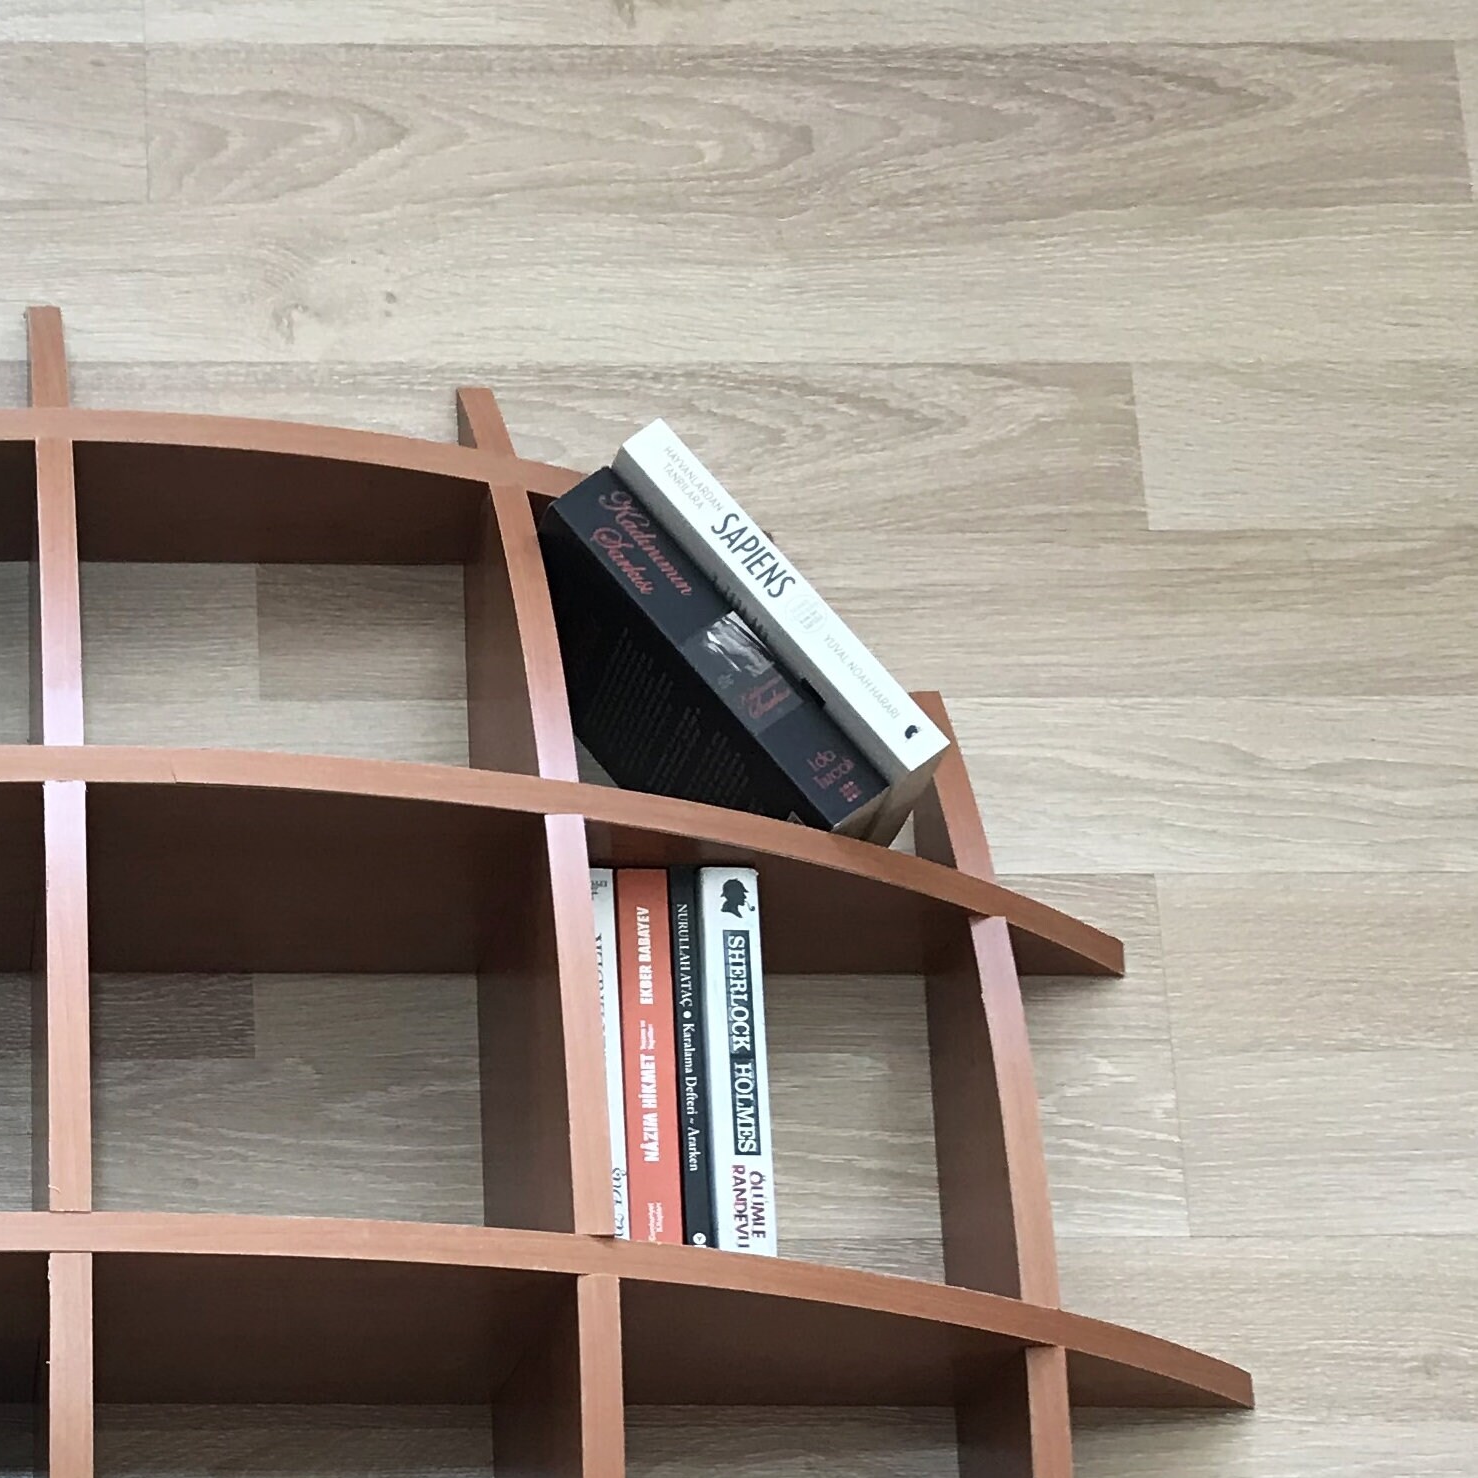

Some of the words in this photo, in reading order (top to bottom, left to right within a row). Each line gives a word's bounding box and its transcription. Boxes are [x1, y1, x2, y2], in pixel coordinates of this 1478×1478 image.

[663, 462, 704, 510] TANRILARA
[664, 446, 725, 512] HAYVANLARDAN
[710, 512, 796, 598] SAPIENS
[823, 634, 849, 663] YUVAL
[847, 661, 874, 688] NOAH
[869, 686, 901, 719] HARARI
[636, 906, 652, 963] BABAYEV
[676, 903, 690, 971] NURULLAH
[638, 965, 653, 1005] EKBER
[679, 972, 693, 1008] ATAÇ
[728, 935, 751, 1052] SHERLOCK
[682, 1022, 697, 1075] Karalama
[638, 1053, 657, 1109] HİKMET
[685, 1077, 700, 1116] Defteri
[733, 1063, 756, 1153] HOLMES
[687, 1126, 701, 1172] Ararken
[732, 1165, 750, 1248] RANDEVU
[749, 1171, 769, 1238] ÖLÜMLE
